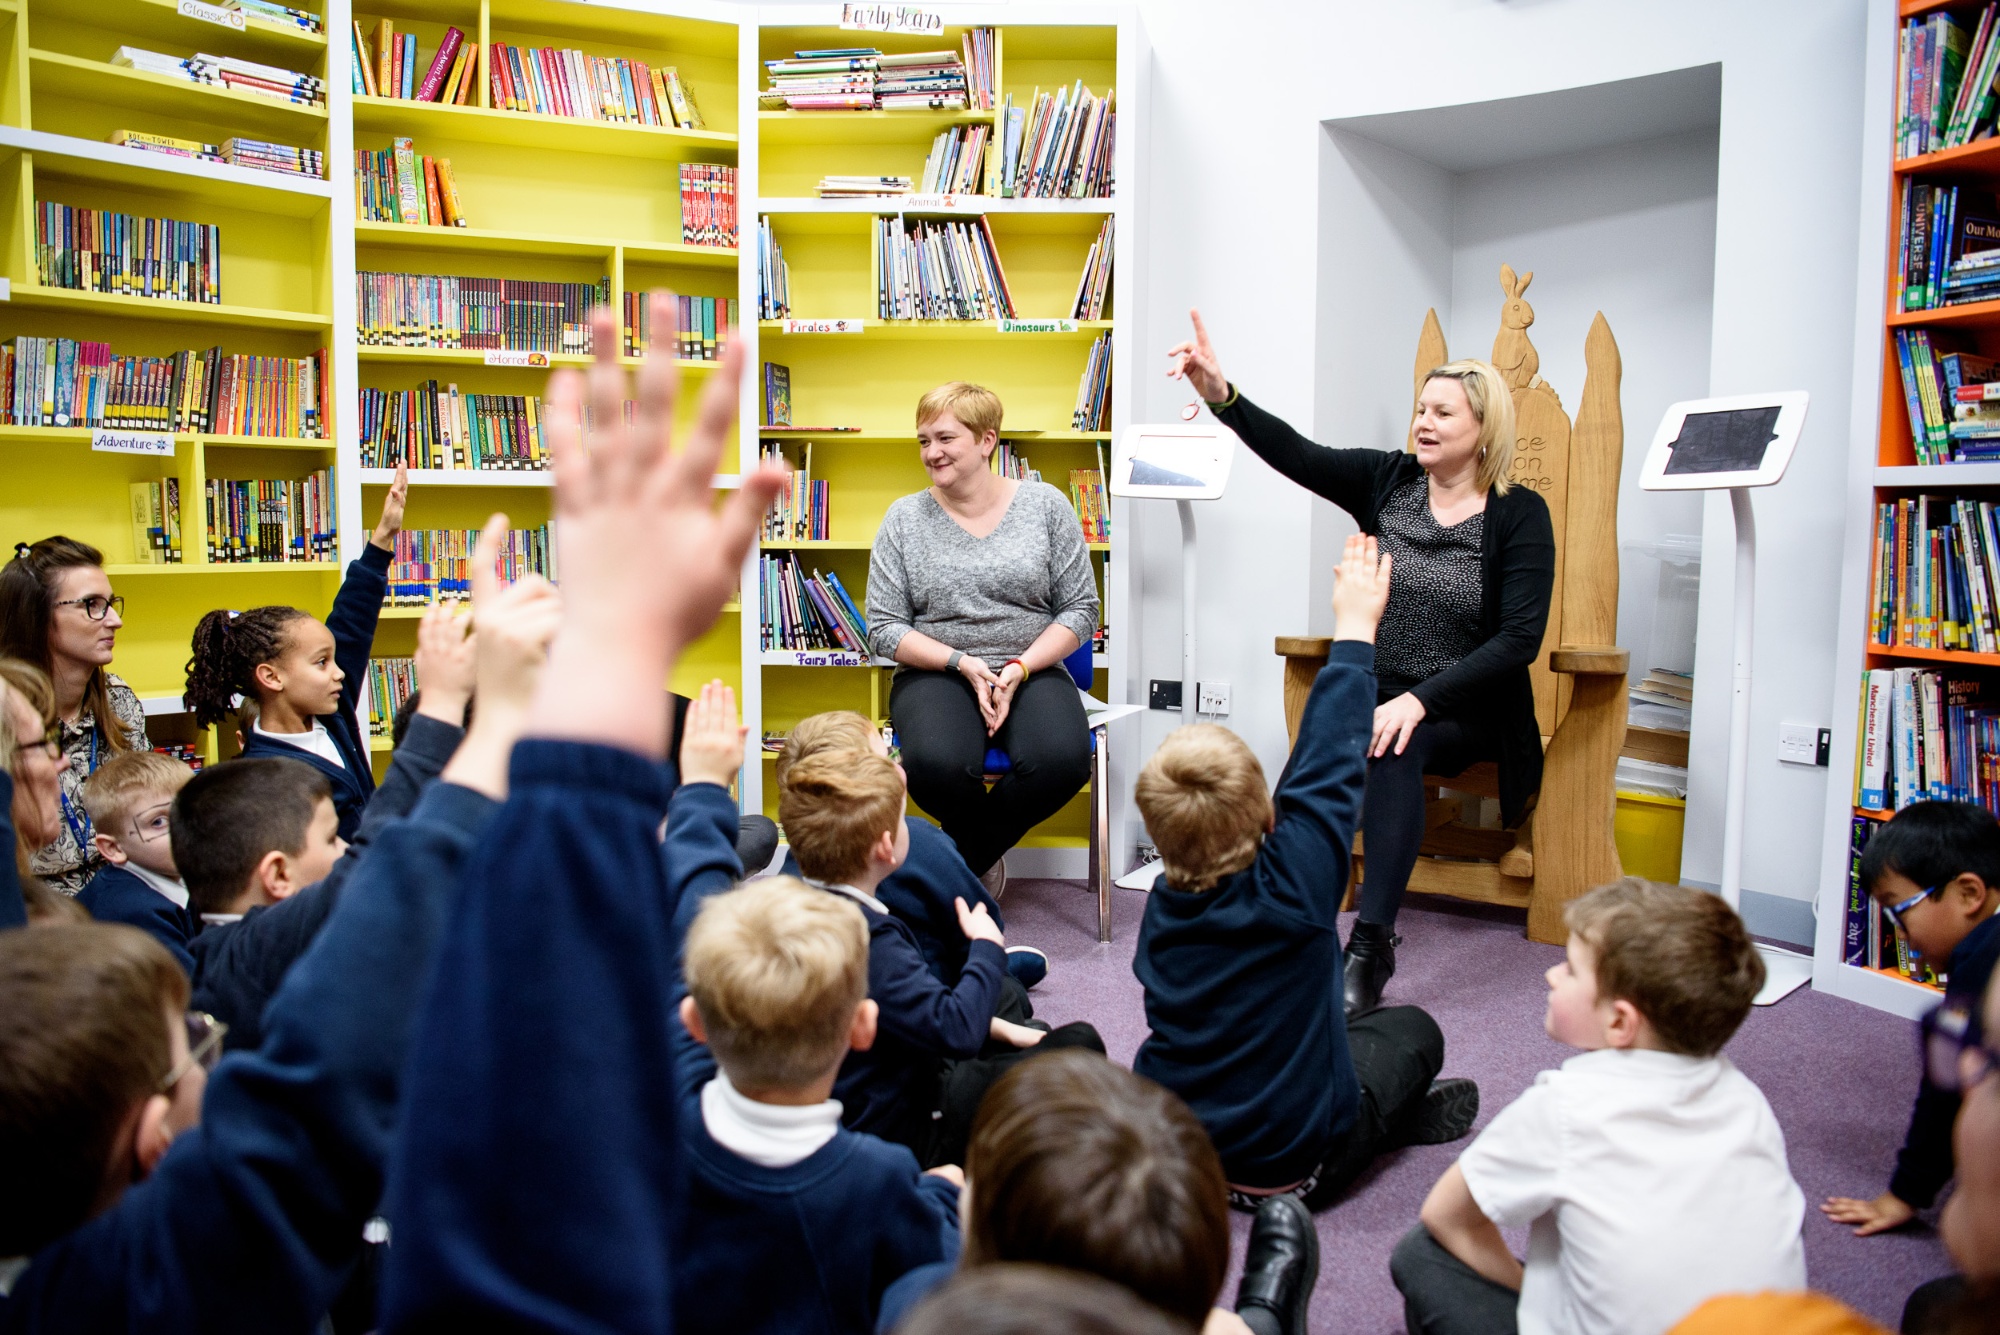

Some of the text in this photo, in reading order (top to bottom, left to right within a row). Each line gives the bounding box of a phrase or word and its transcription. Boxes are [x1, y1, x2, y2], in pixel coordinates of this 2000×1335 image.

[183, 2, 226, 24] Classic
[842, 3, 941, 31] Early Years
[423, 55, 448, 97] AWFUL AUNTIE
[908, 197, 940, 206] Animal
[1913, 203, 1925, 270] UNIVERSE
[1966, 222, 1985, 236] Our
[790, 320, 830, 333] Pirates
[1003, 320, 1055, 332] Dinosaurs
[489, 353, 527, 365] Horror
[439, 398, 447, 429] SMEKDAY
[95, 435, 152, 450] Adventure
[1516, 436, 1546, 451] ce
[1513, 456, 1541, 473] on
[795, 652, 858, 666] Fairy Tales
[1948, 681, 1980, 694] History
[1949, 695, 1968, 705] of the
[1866, 685, 1879, 766] Manchester United
[1848, 922, 1859, 946] 2011
[1898, 940, 1909, 970] GUINNE
